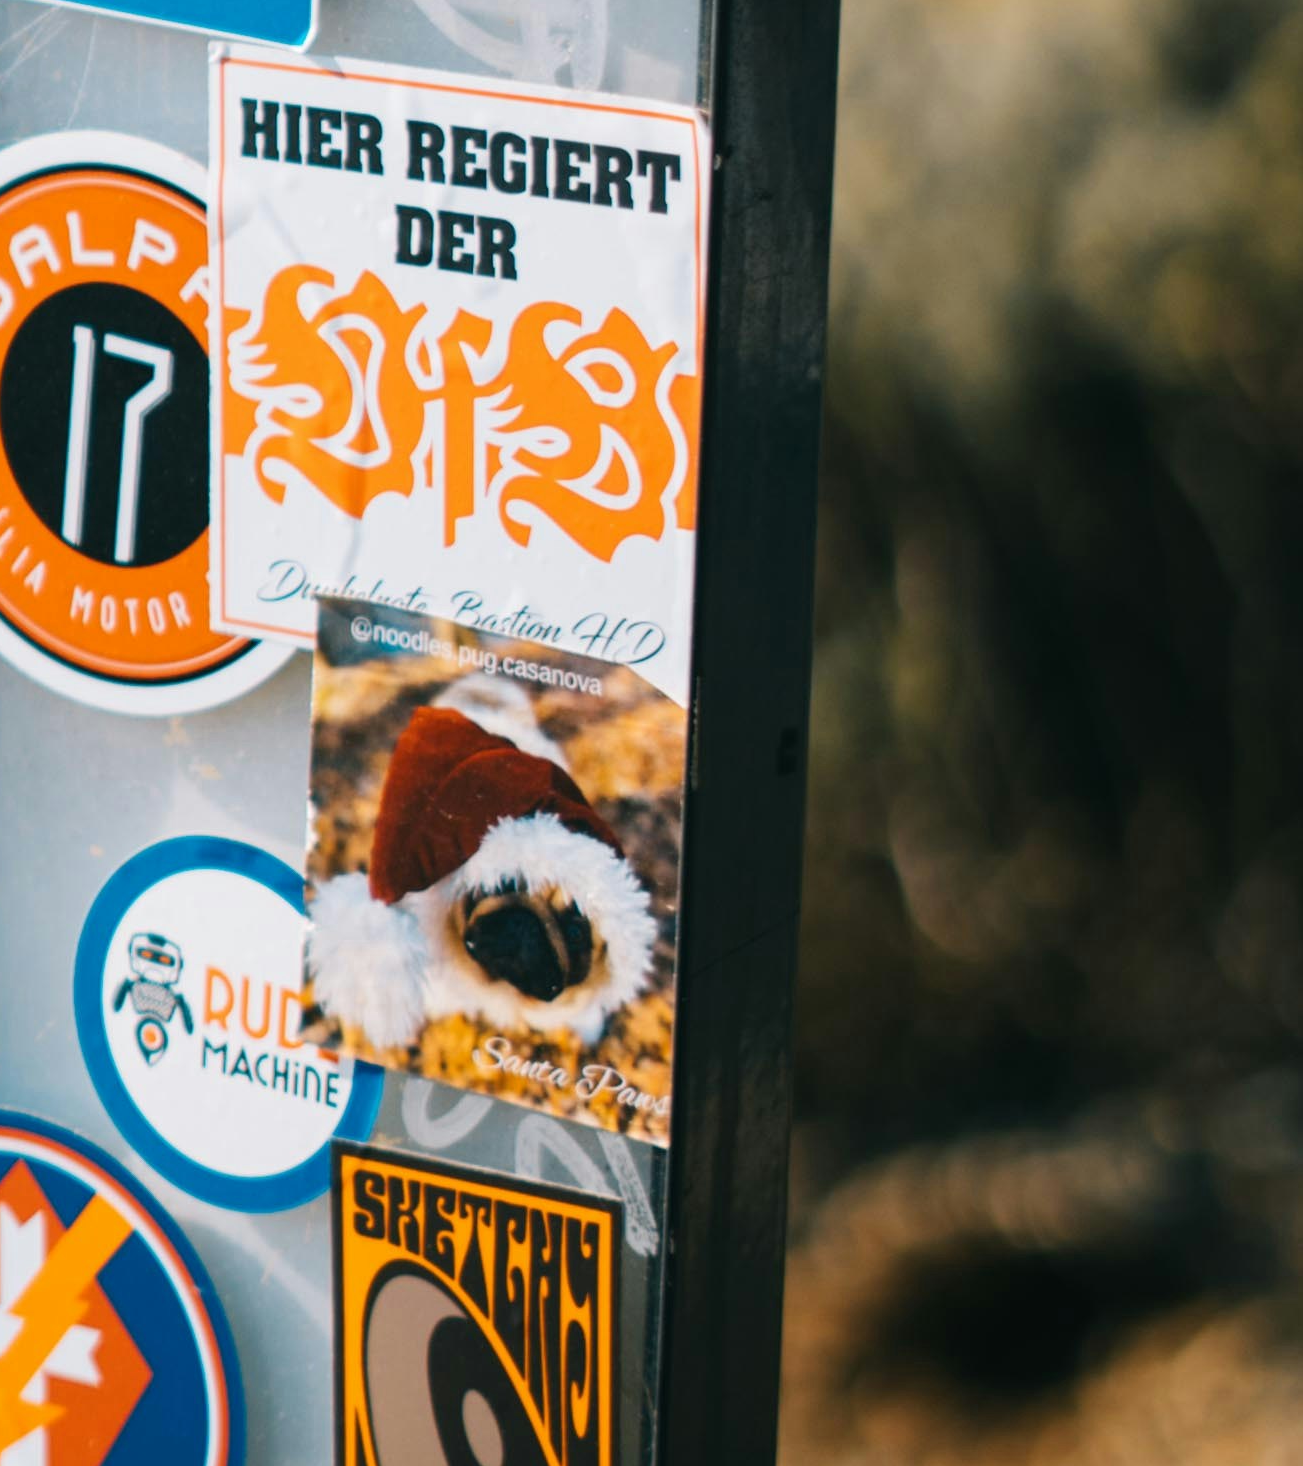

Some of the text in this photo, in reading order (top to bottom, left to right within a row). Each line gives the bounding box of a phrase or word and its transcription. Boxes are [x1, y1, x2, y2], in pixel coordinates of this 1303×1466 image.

[240, 96, 682, 216] HIER REGIERT
[395, 203, 519, 282] DER
[61, 324, 175, 566] 17
[69, 584, 193, 636] MOTOR
[450, 589, 564, 644] Bastion
[571, 611, 666, 666] HD
[349, 615, 605, 698] @noodles.pug.casanova
[203, 964, 338, 1062] RUD
[471, 1035, 670, 1115] Santa Paws
